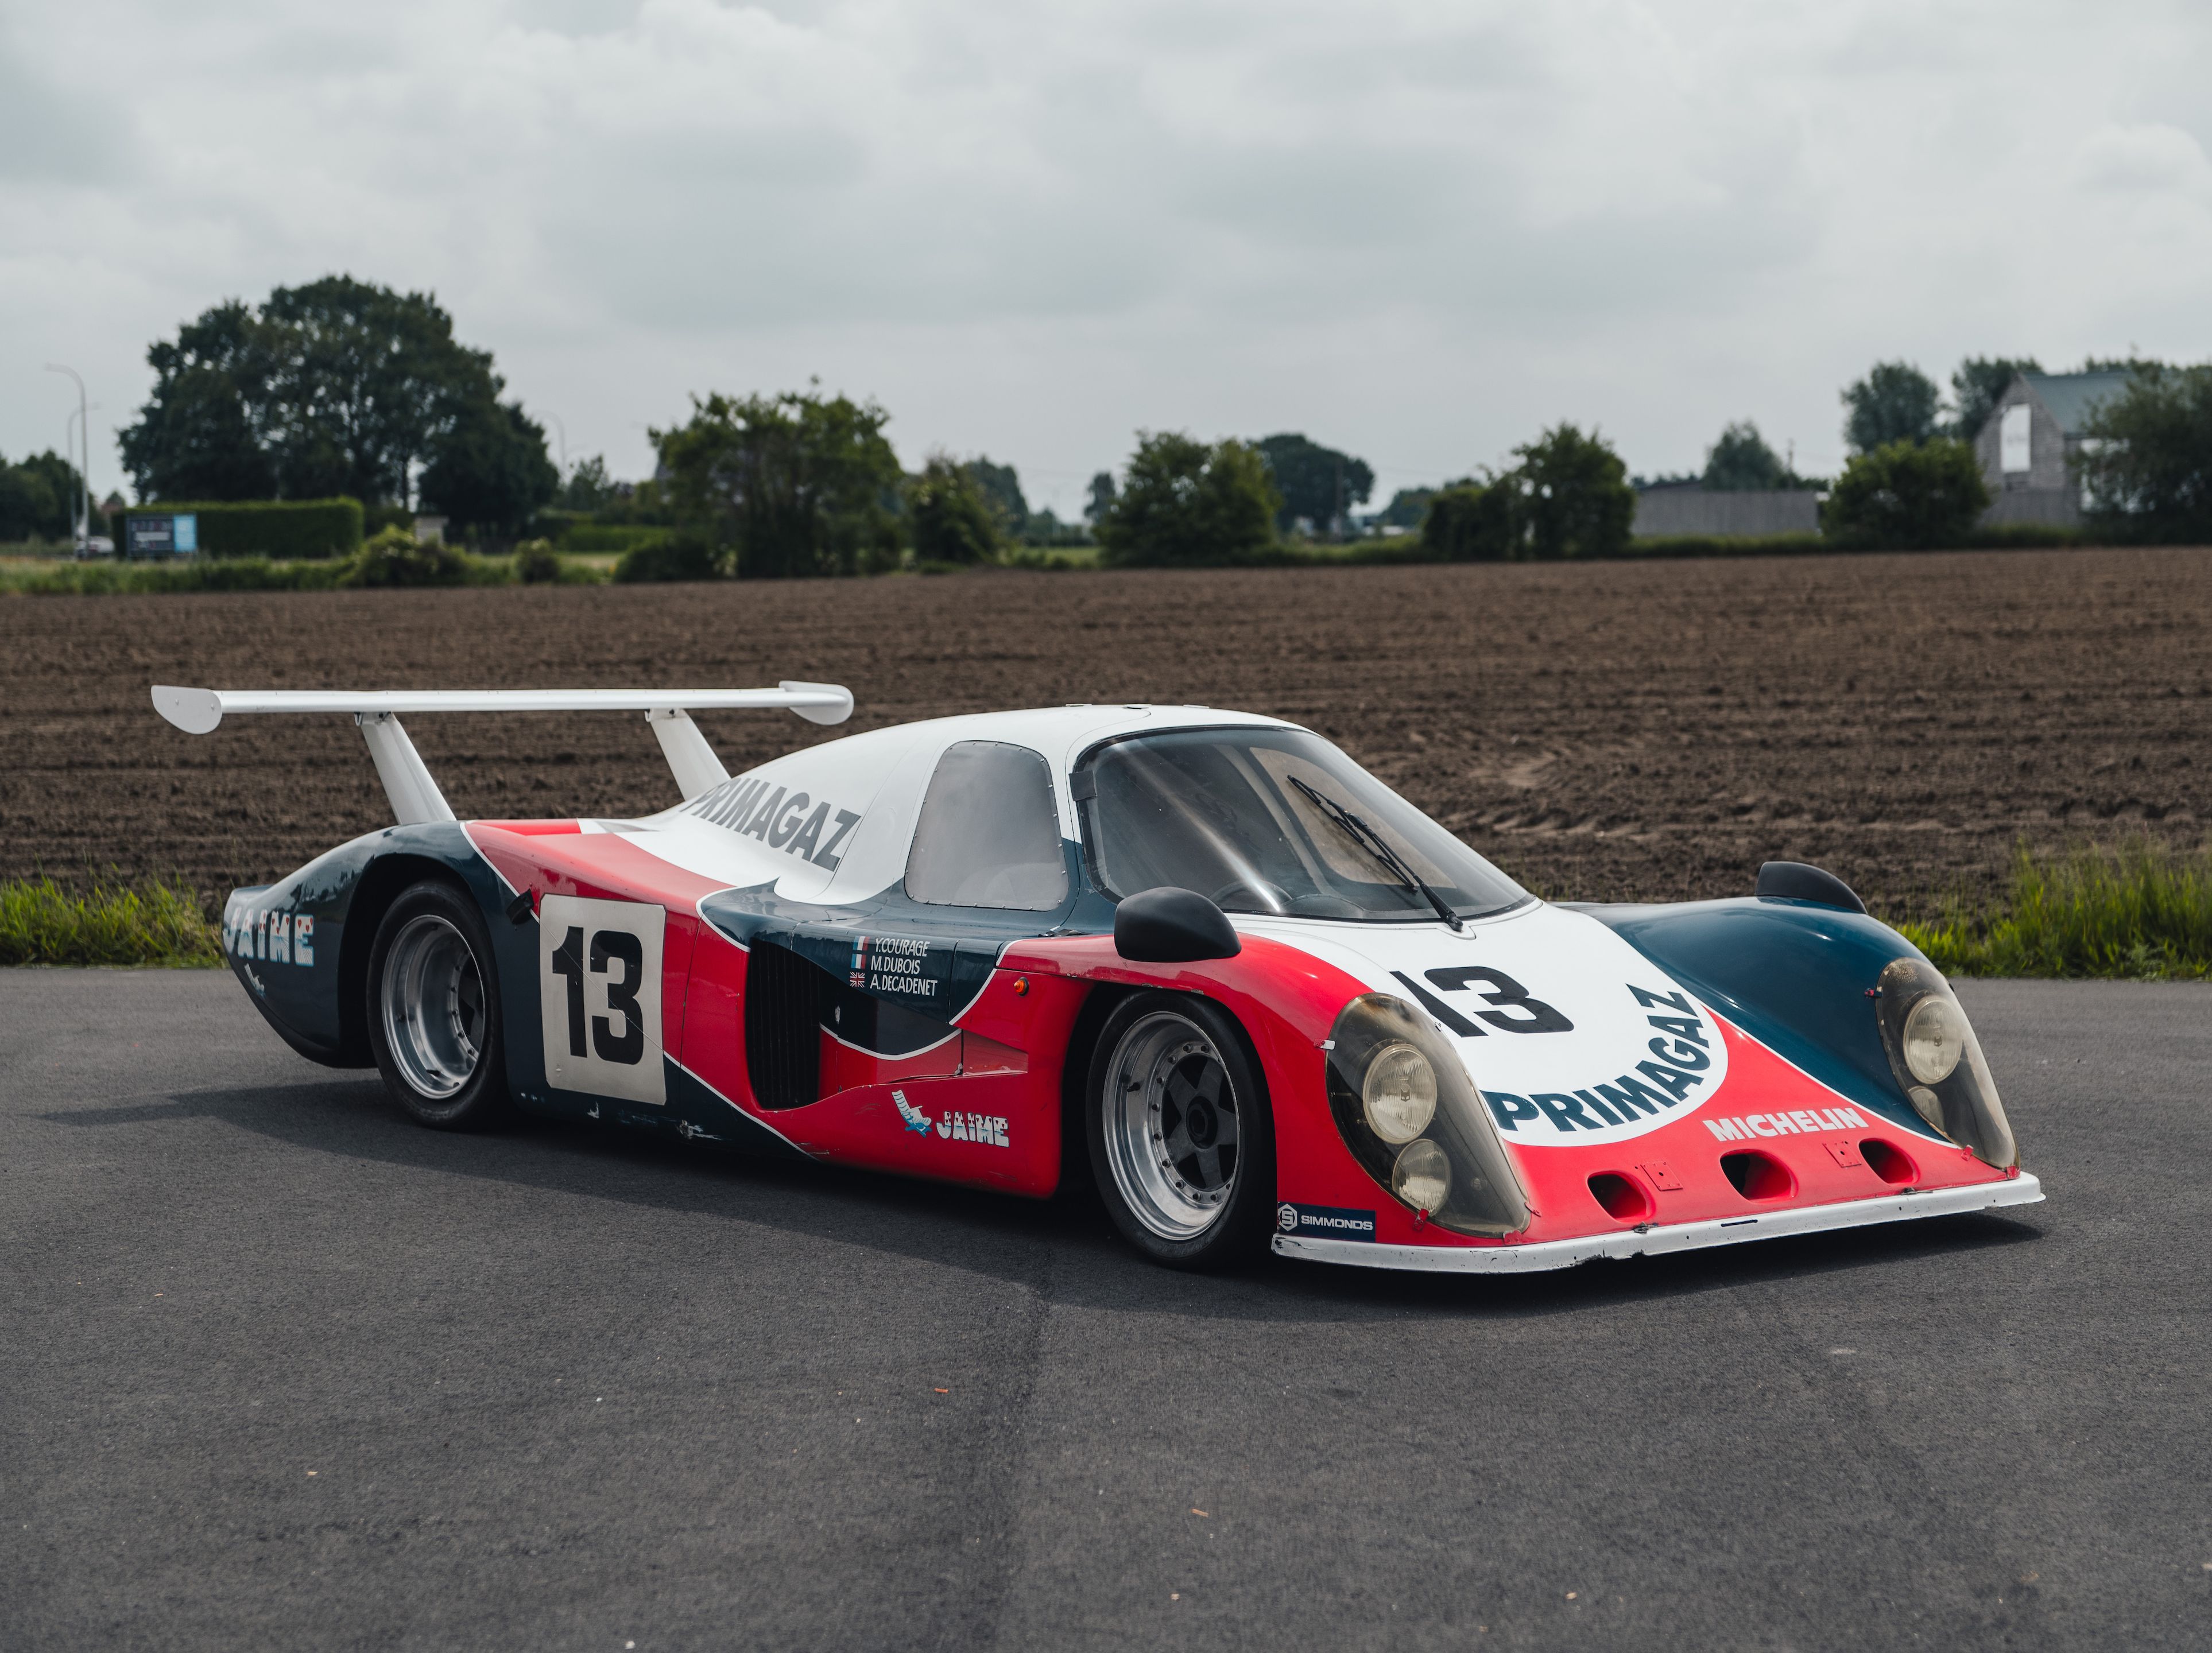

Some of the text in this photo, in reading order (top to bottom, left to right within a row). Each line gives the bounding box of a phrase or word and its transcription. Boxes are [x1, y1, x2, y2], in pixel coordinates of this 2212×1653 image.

[222, 905, 315, 968] JAIME
[552, 926, 644, 1065] 13
[1389, 966, 1574, 1037] 13
[1480, 984, 1710, 1132] PRIMAGAZ
[936, 1111, 1010, 1148] JAIME
[1703, 1107, 1869, 1142] MICHELIN
[1301, 1215, 1373, 1231] SIMMONDS
